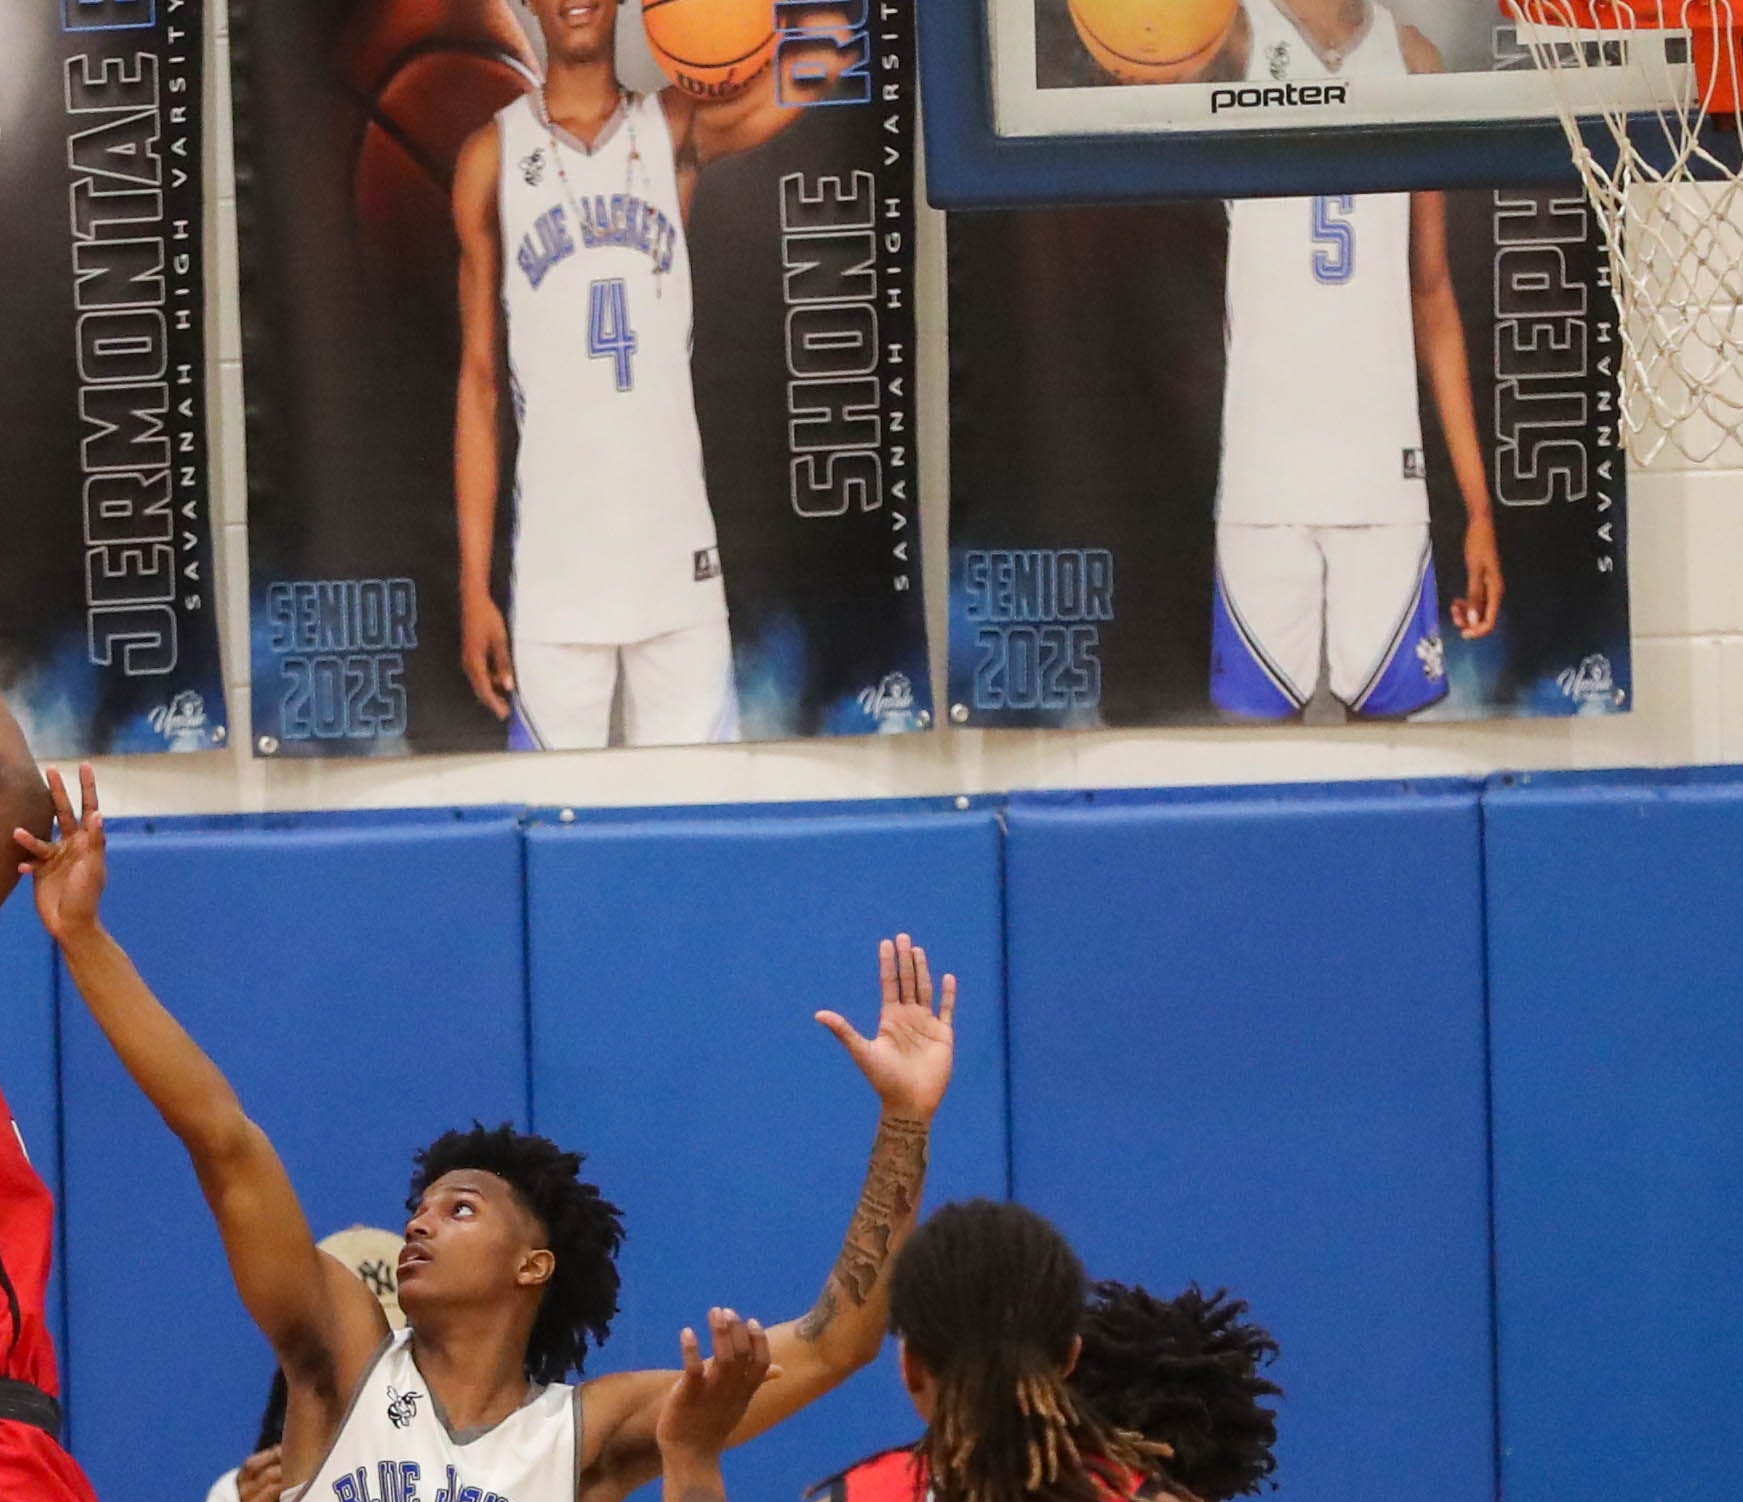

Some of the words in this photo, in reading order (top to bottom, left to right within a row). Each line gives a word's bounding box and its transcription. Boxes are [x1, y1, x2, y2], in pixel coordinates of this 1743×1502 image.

[1211, 83, 1346, 114] porter
[173, 219, 191, 330] HIGH
[517, 203, 576, 291] BLUE
[884, 198, 902, 308] HIGH
[1312, 193, 1355, 285] 5
[64, 51, 178, 677] JERMONTAE
[587, 277, 639, 393] 4
[779, 169, 883, 518] SHONE
[176, 363, 202, 611] SAVANNAH
[887, 343, 911, 591] SAVANNAH
[1596, 321, 1614, 573] SAVANNAH
[266, 576, 419, 653] SENIOR
[965, 547, 1115, 622] SENIOR
[280, 653, 408, 740] 2025
[974, 623, 1102, 710] 2025
